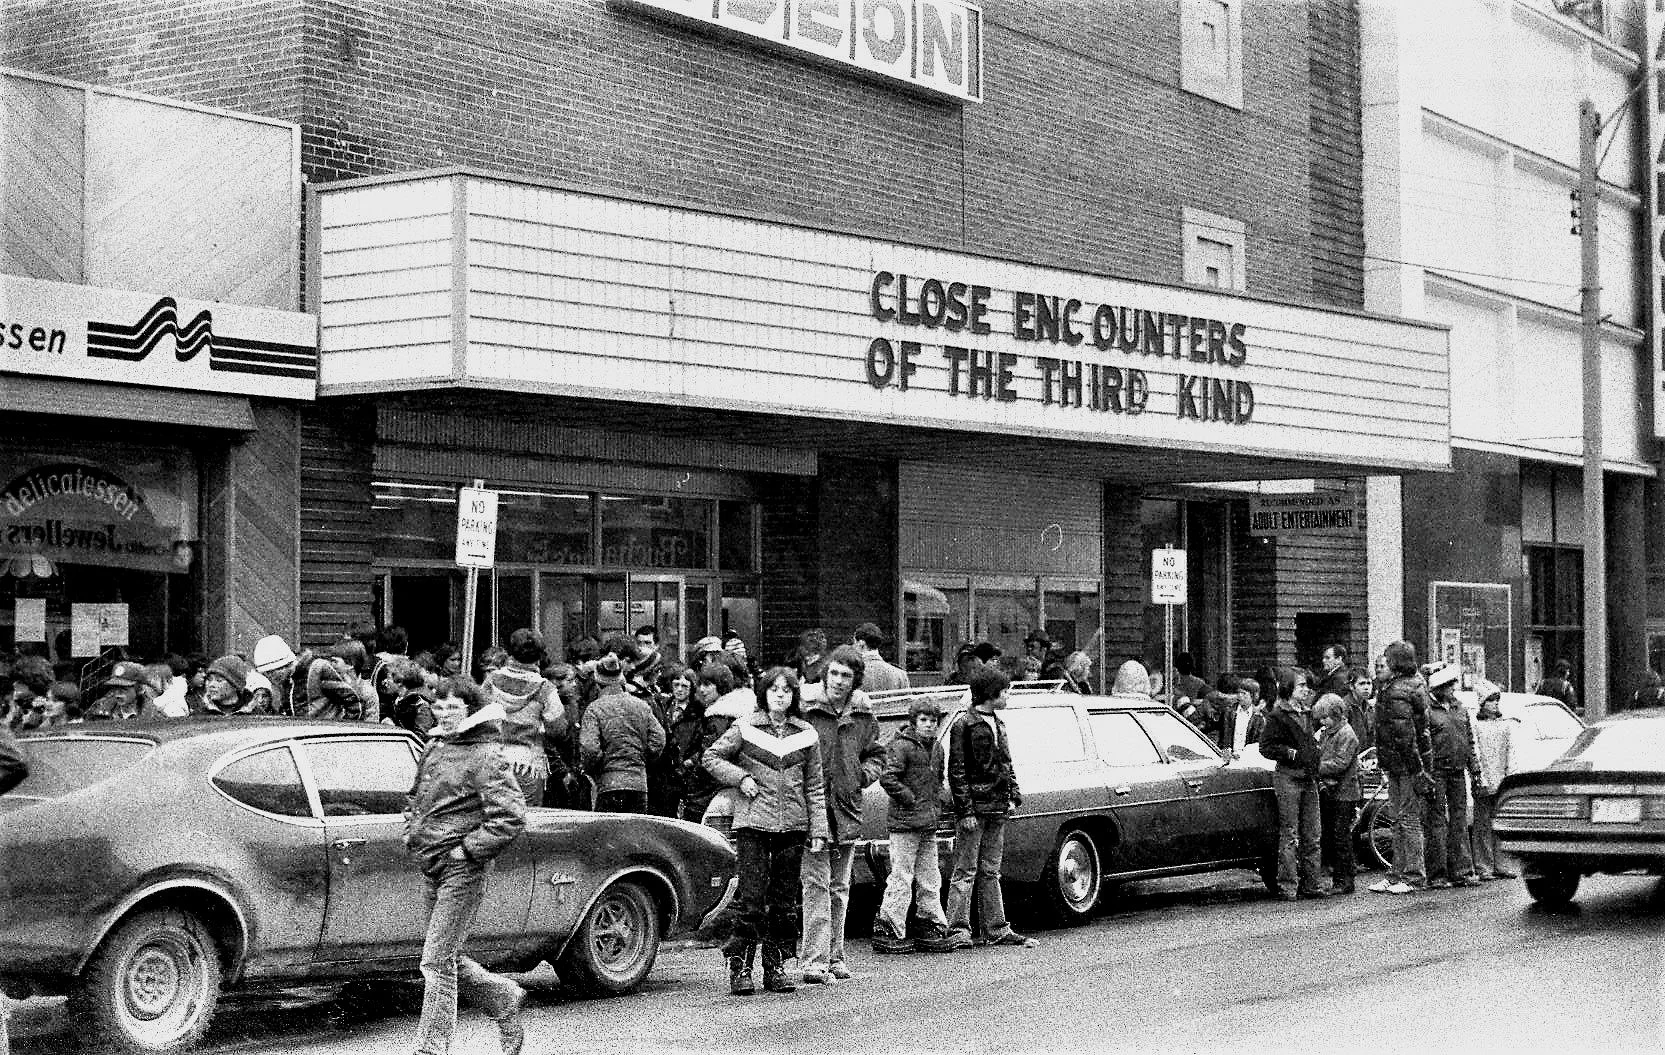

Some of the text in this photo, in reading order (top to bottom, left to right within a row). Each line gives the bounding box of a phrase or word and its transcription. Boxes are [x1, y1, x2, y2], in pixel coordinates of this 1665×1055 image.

[870, 270, 991, 335] CLOSE
[865, 337, 1255, 426] OF THE THIRD KIND
[5, 468, 140, 521] delicatessen
[471, 500, 486, 514] NO
[461, 517, 493, 535] PARKING
[1252, 508, 1353, 530] ADULT ENTERTAINMENT
[1162, 556, 1176, 568] NO
[1154, 570, 1184, 581] PARKING
